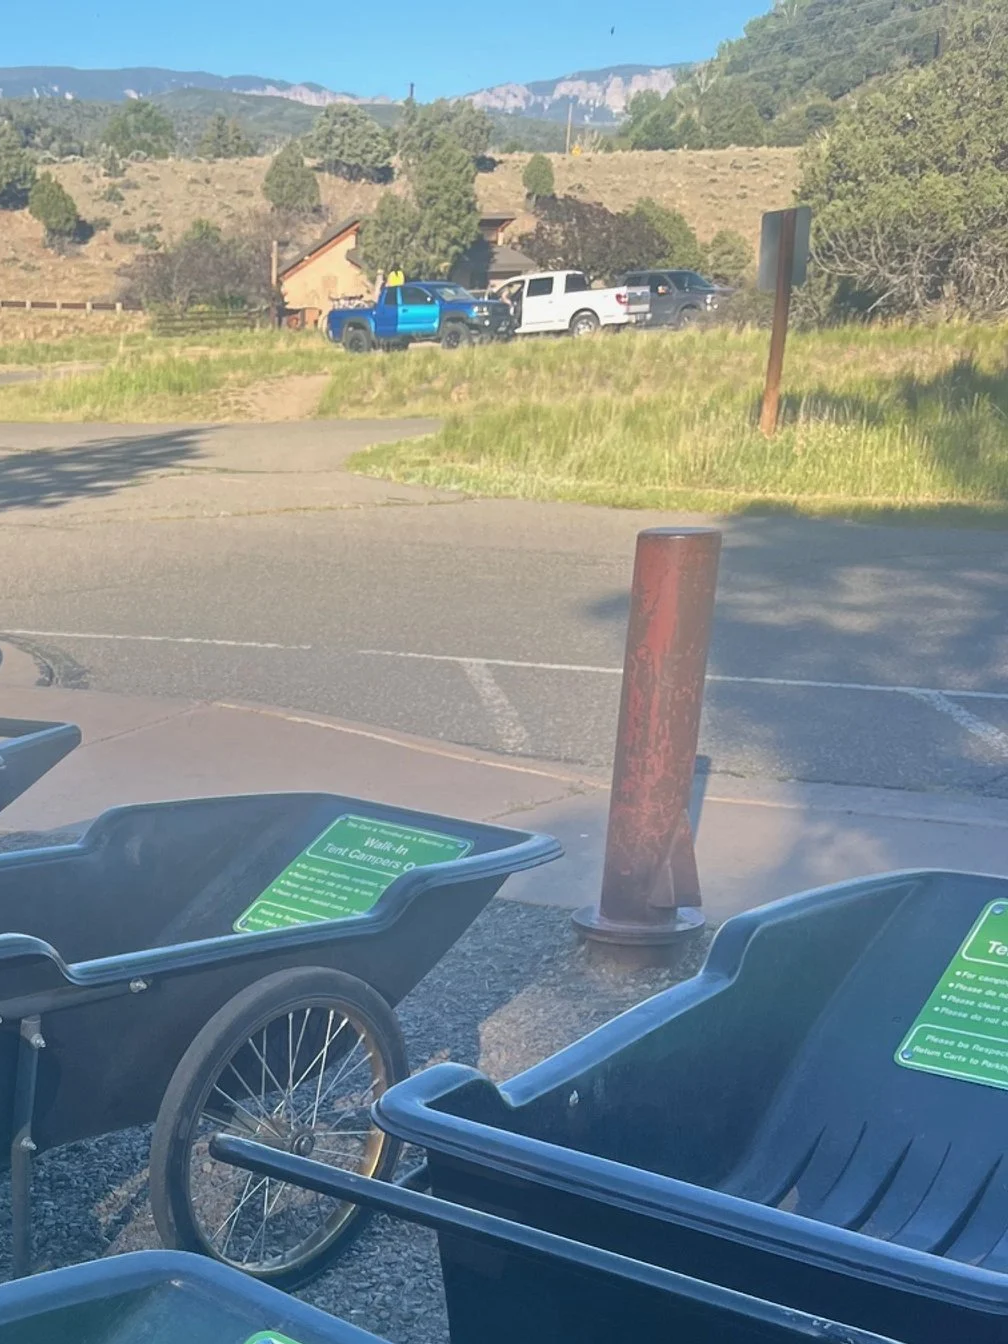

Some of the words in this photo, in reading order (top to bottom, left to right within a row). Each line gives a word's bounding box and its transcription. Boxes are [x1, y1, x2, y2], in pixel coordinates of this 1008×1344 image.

[363, 836, 409, 856] Walk-In
[323, 842, 348, 857] Tent
[348, 848, 401, 870] Campers
[988, 940, 1008, 956] Te
[955, 982, 983, 994] Please
[978, 975, 1008, 987] campin
[947, 994, 975, 1006] Please
[926, 1034, 955, 1047] Please
[957, 1039, 970, 1050] be
[912, 1045, 941, 1057] Return
[943, 1052, 966, 1063] Carts
[970, 1057, 980, 1066] to
[981, 1060, 1008, 1072] Parkin
